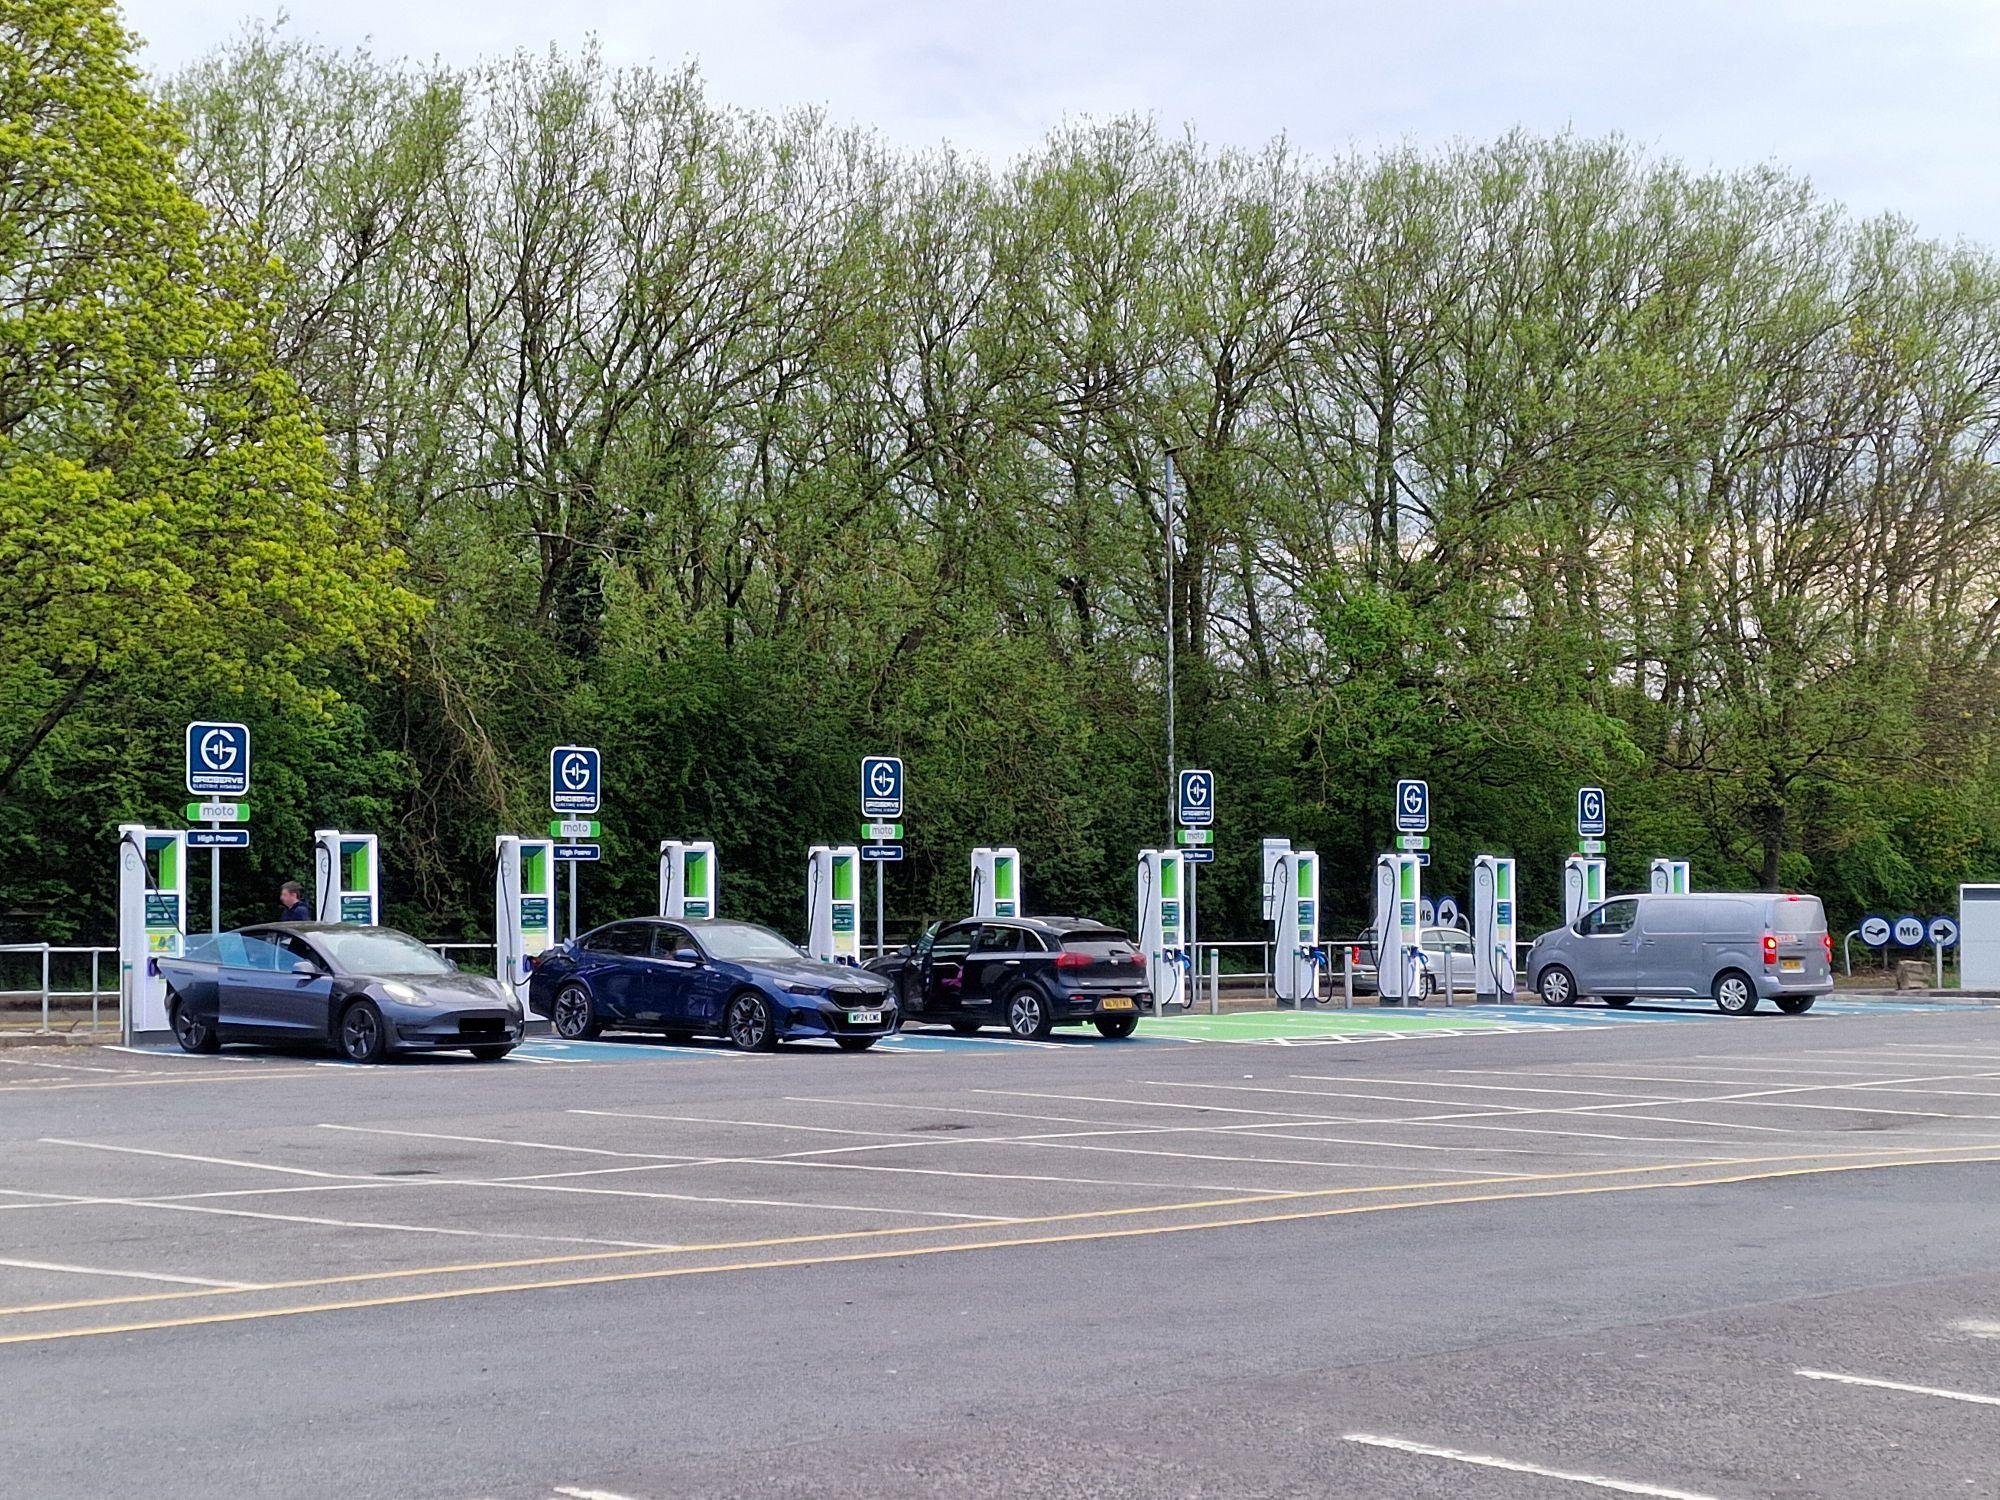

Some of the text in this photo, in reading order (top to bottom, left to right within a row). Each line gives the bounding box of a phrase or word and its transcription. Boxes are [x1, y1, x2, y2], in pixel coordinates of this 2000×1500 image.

[202, 805, 235, 816] moto
[563, 823, 589, 832] moto
[872, 826, 893, 835] moto
[197, 834, 239, 843] High Power
[1186, 832, 1205, 840] moto
[559, 849, 573, 857] High
[1899, 926, 1920, 937] M6
